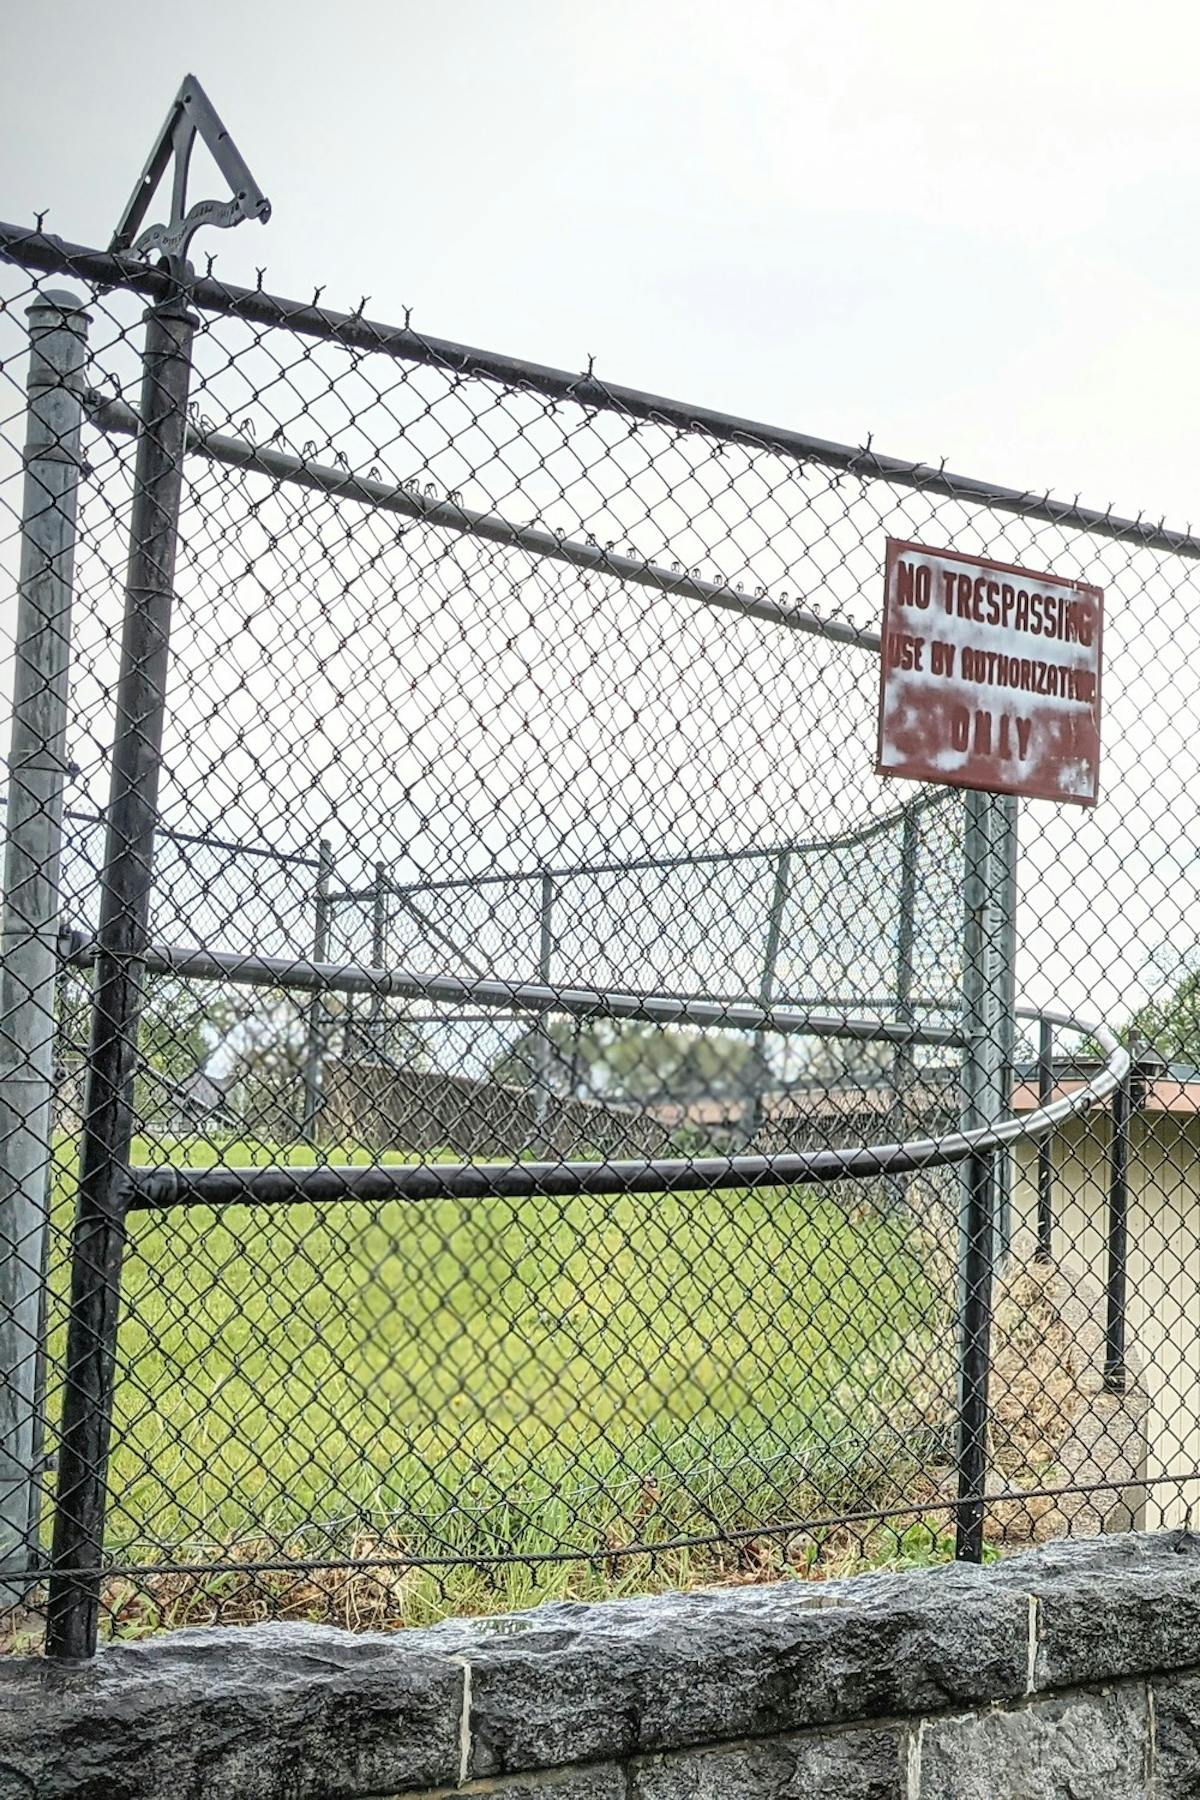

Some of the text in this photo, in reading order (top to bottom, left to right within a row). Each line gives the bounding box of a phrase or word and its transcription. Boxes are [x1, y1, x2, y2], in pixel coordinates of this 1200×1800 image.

[898, 560, 1093, 647] NO TRESPASSING
[888, 632, 925, 672] USE
[931, 640, 956, 678] BY
